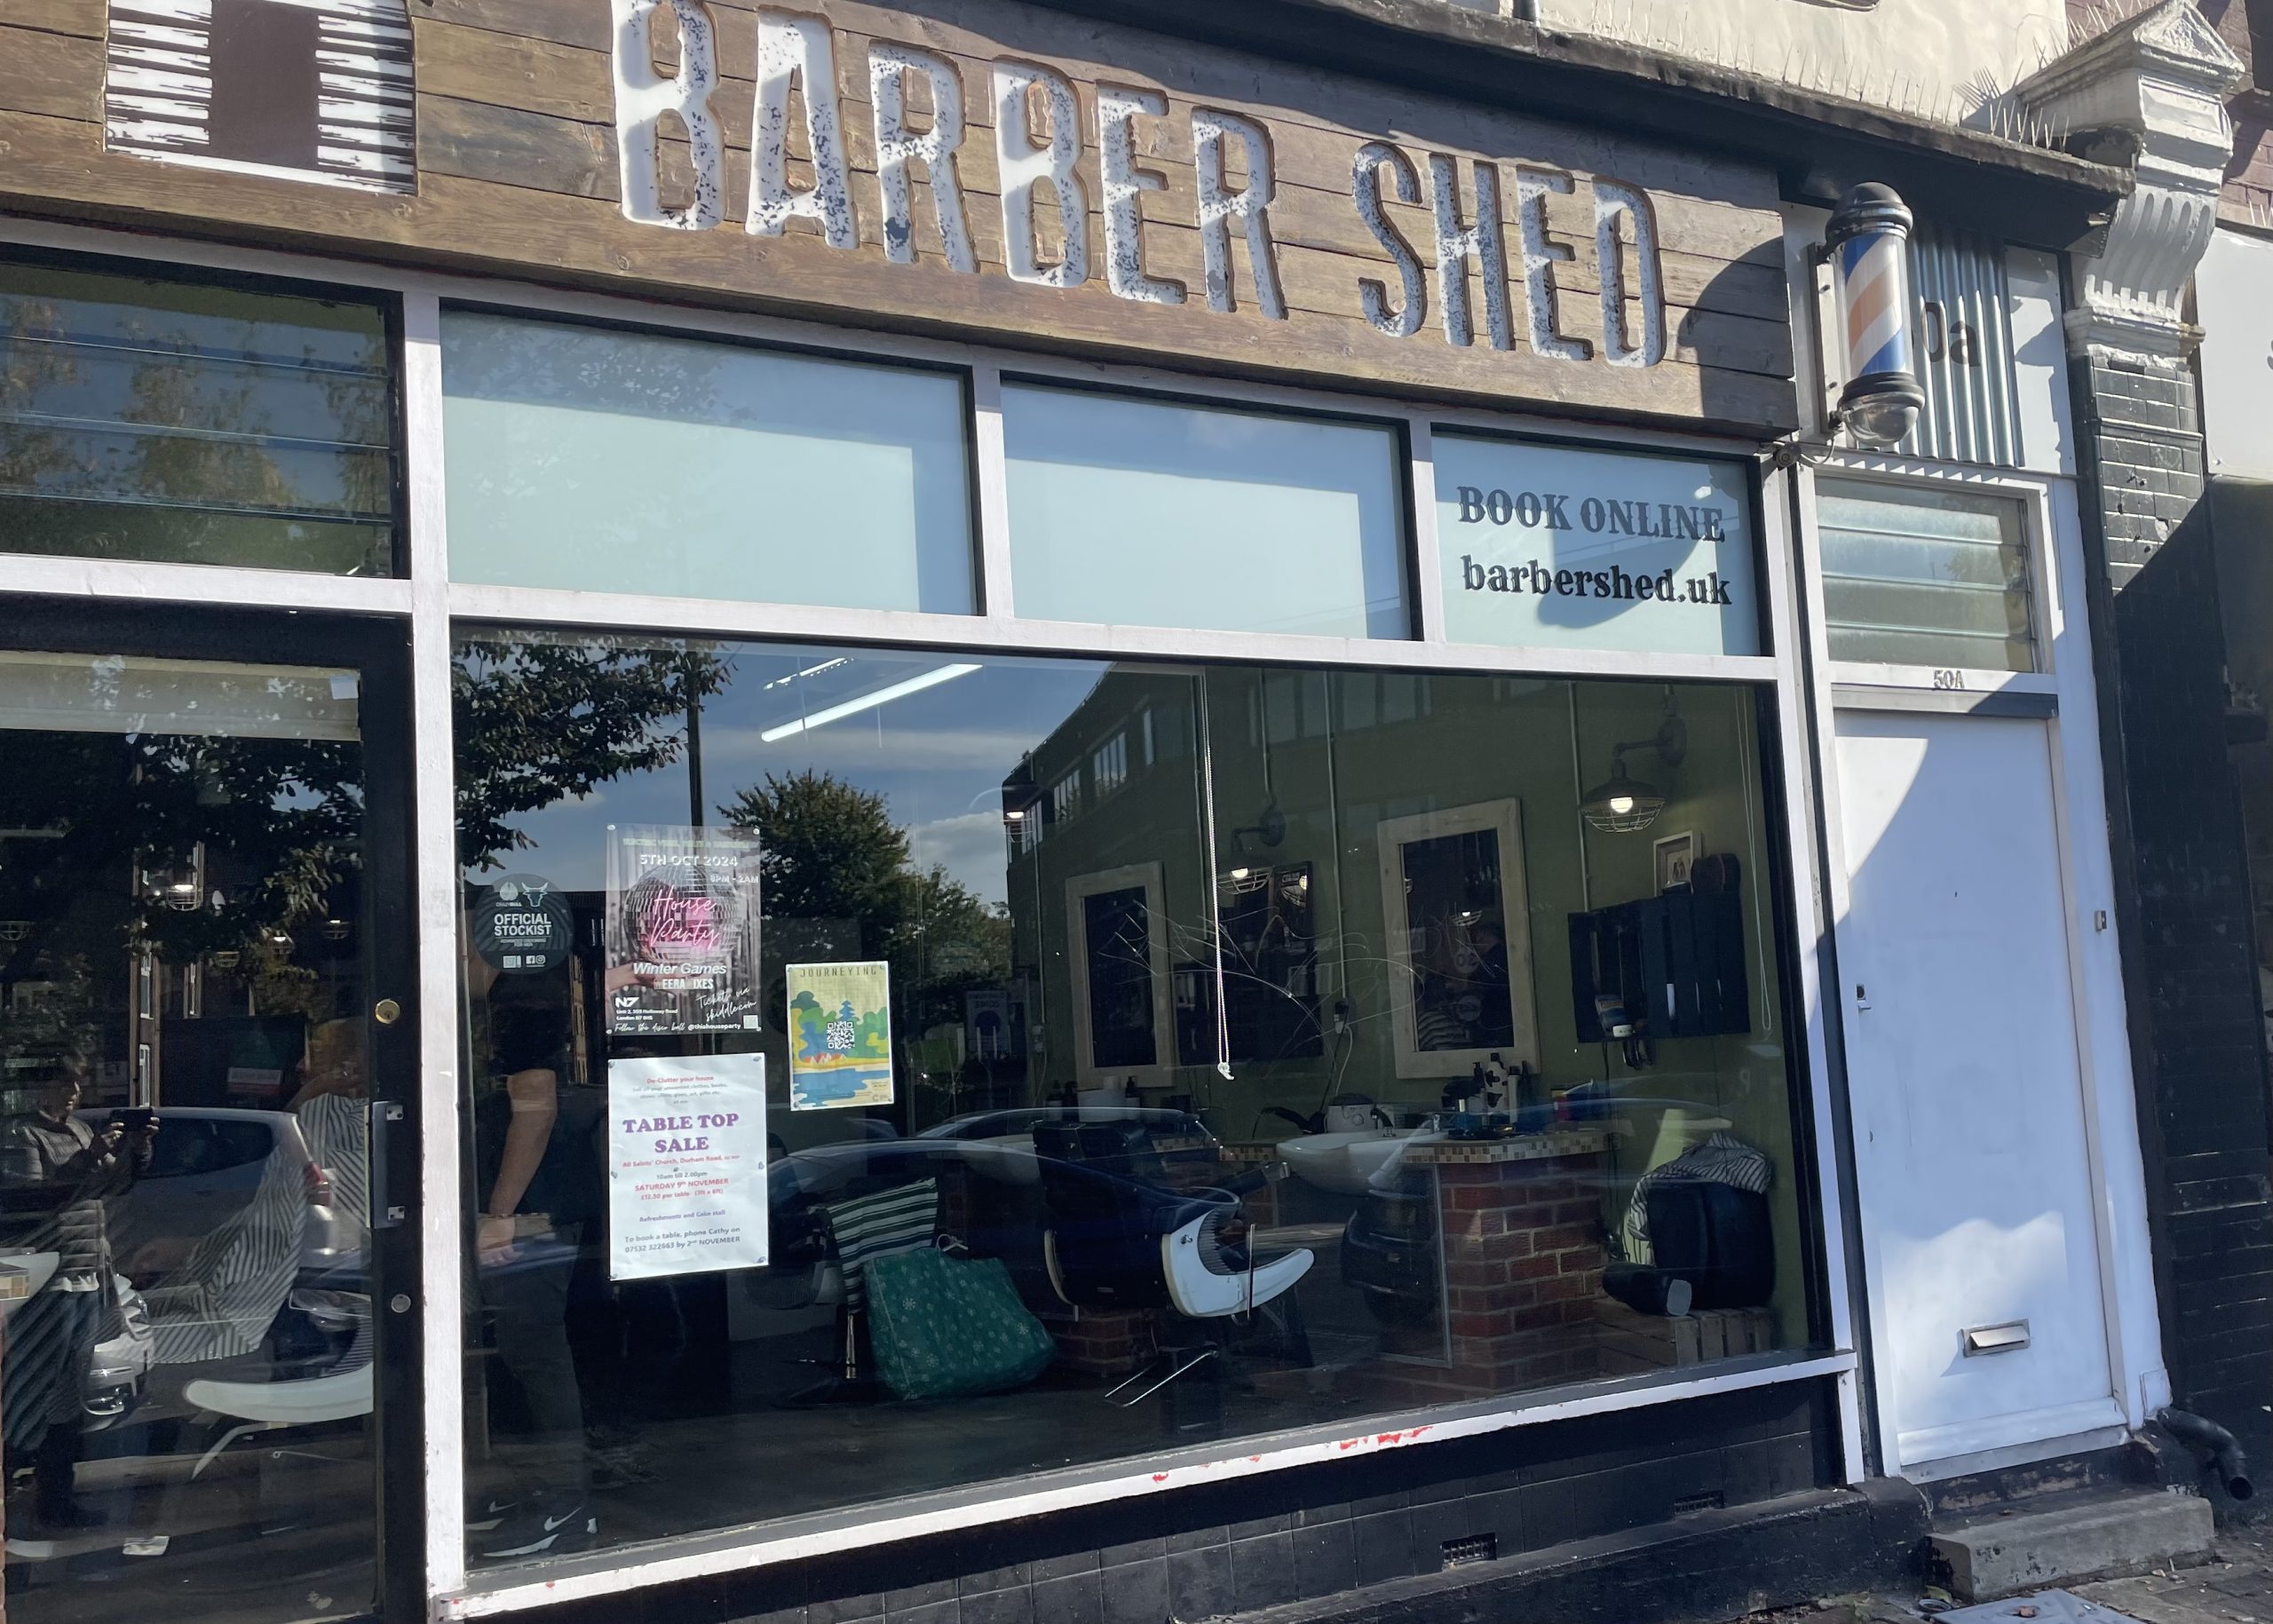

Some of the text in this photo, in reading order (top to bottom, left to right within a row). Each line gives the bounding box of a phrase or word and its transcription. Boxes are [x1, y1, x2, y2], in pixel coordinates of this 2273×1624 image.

[610, 0, 1667, 368] BARBER SHED
[1912, 302, 1981, 367] 0a
[1457, 486, 1726, 543] BOOK ONLINE
[1460, 555, 1731, 605] barbershed.uk
[1934, 669, 1965, 689] 50A
[639, 854, 739, 867] 5TH OCT 2024
[653, 884, 717, 918] House
[494, 914, 551, 924] OFFICIAL
[494, 925, 551, 936] STOCKIST
[649, 917, 720, 951] Party
[633, 963, 727, 974] Winter Games
[800, 966, 877, 978] JOURNEYING
[615, 997, 640, 1008] N7
[695, 986, 750, 1010] Tickets via
[614, 1022, 636, 1032] Follow
[638, 1022, 649, 1032] the
[652, 1022, 669, 1032] disco
[622, 1113, 740, 1133] TABLE TOP
[654, 1137, 709, 1153] SALE
[635, 1183, 675, 1192] SATURDAY
[699, 1236, 741, 1245] NOVEMBER
